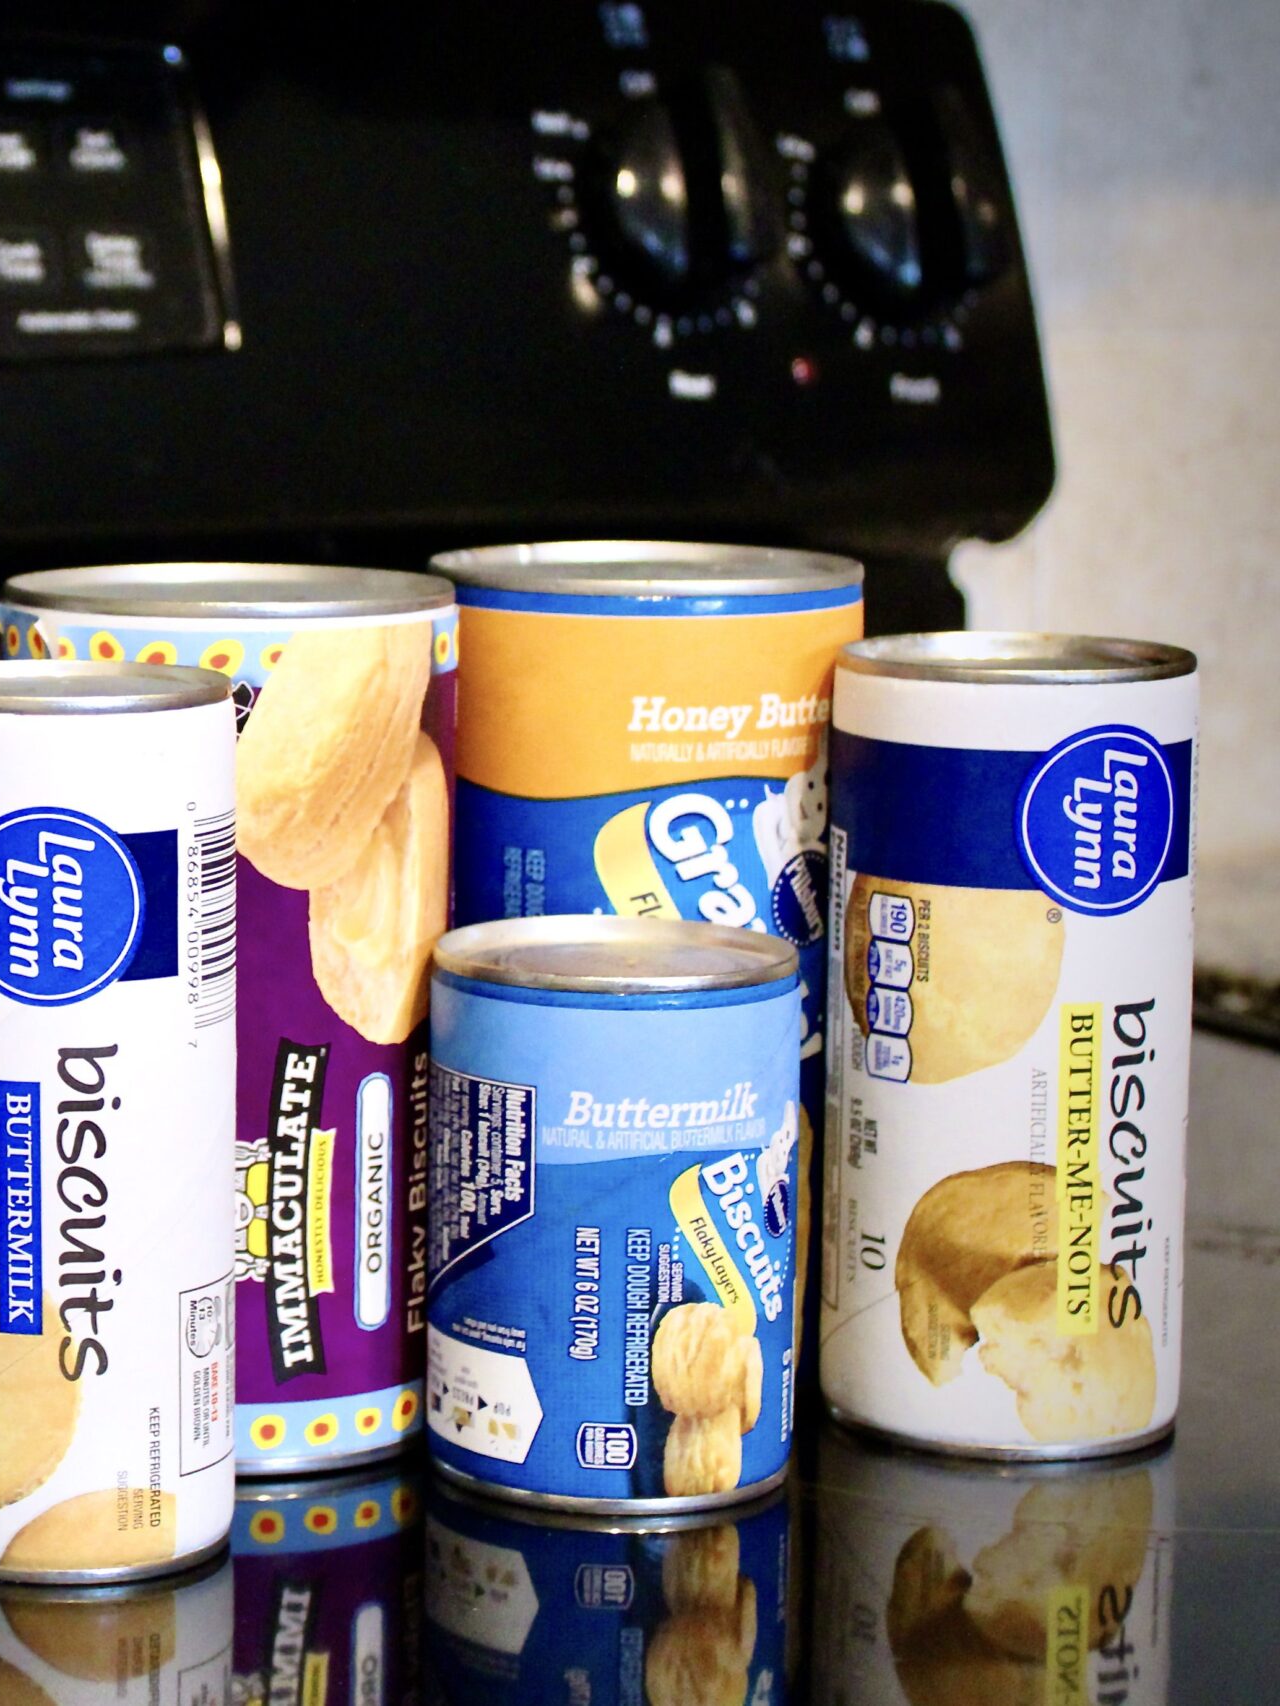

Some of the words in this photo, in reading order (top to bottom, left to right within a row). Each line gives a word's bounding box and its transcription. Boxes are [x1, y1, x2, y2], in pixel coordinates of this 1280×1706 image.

[627, 696, 753, 739] Honey
[1062, 777, 1112, 889] Lynn
[1104, 749, 1148, 880] Laura
[39, 830, 95, 972] Laura
[186, 845, 199, 918] 86854
[833, 834, 844, 950] Nutrition
[890, 903, 907, 934] 190
[918, 899, 931, 919] PER
[918, 923, 931, 931] 2
[186, 931, 199, 1004] 00998
[916, 932, 930, 982] BISCUITS
[505, 1088, 527, 1157] Nutrition
[563, 1081, 760, 1129] Buttermilk
[407, 1051, 427, 1213] Biscuits
[460, 1130, 472, 1177] Calories
[542, 1125, 592, 1148] NATURAL
[594, 1128, 606, 1149] &
[607, 1127, 668, 1150] ARTIFICIAL
[670, 1123, 734, 1149] BUTTERMILK
[315, 1140, 327, 1210] DELICIOUS
[504, 1159, 526, 1202] Facts
[1108, 997, 1155, 1329] biscuits
[5, 1092, 35, 1325] BUTTERMILK
[56, 1043, 122, 1382] biscuits
[272, 1052, 319, 1370] IMMACULATE
[366, 1131, 386, 1273] ORGANIC
[314, 1216, 324, 1283] HONESTLY
[576, 1227, 600, 1255] NET
[627, 1228, 651, 1261] KEEP
[689, 1217, 716, 1259] Flaky
[711, 1256, 739, 1304] Layers
[701, 1151, 784, 1324] Biscuits
[860, 1230, 887, 1271] 10
[575, 1282, 599, 1292] 6
[576, 1257, 599, 1279] WT
[626, 1265, 651, 1309] DOUGH
[658, 1242, 670, 1304] SUGGESTION
[672, 1262, 684, 1303] SERVING
[575, 1295, 599, 1314] OZ
[569, 1316, 598, 1360] (170g)
[624, 1313, 649, 1406] REFRIGERATED
[193, 1371, 201, 1407] GOLDEN
[202, 1367, 210, 1406] MINUTES
[780, 1369, 791, 1443] Biscuits
[149, 1406, 161, 1439] KEEP
[606, 1430, 629, 1463] 100
[116, 1470, 128, 1532] SUGGESTION
[132, 1487, 144, 1530] SERVING
[149, 1441, 161, 1528] REFRIGERATED
